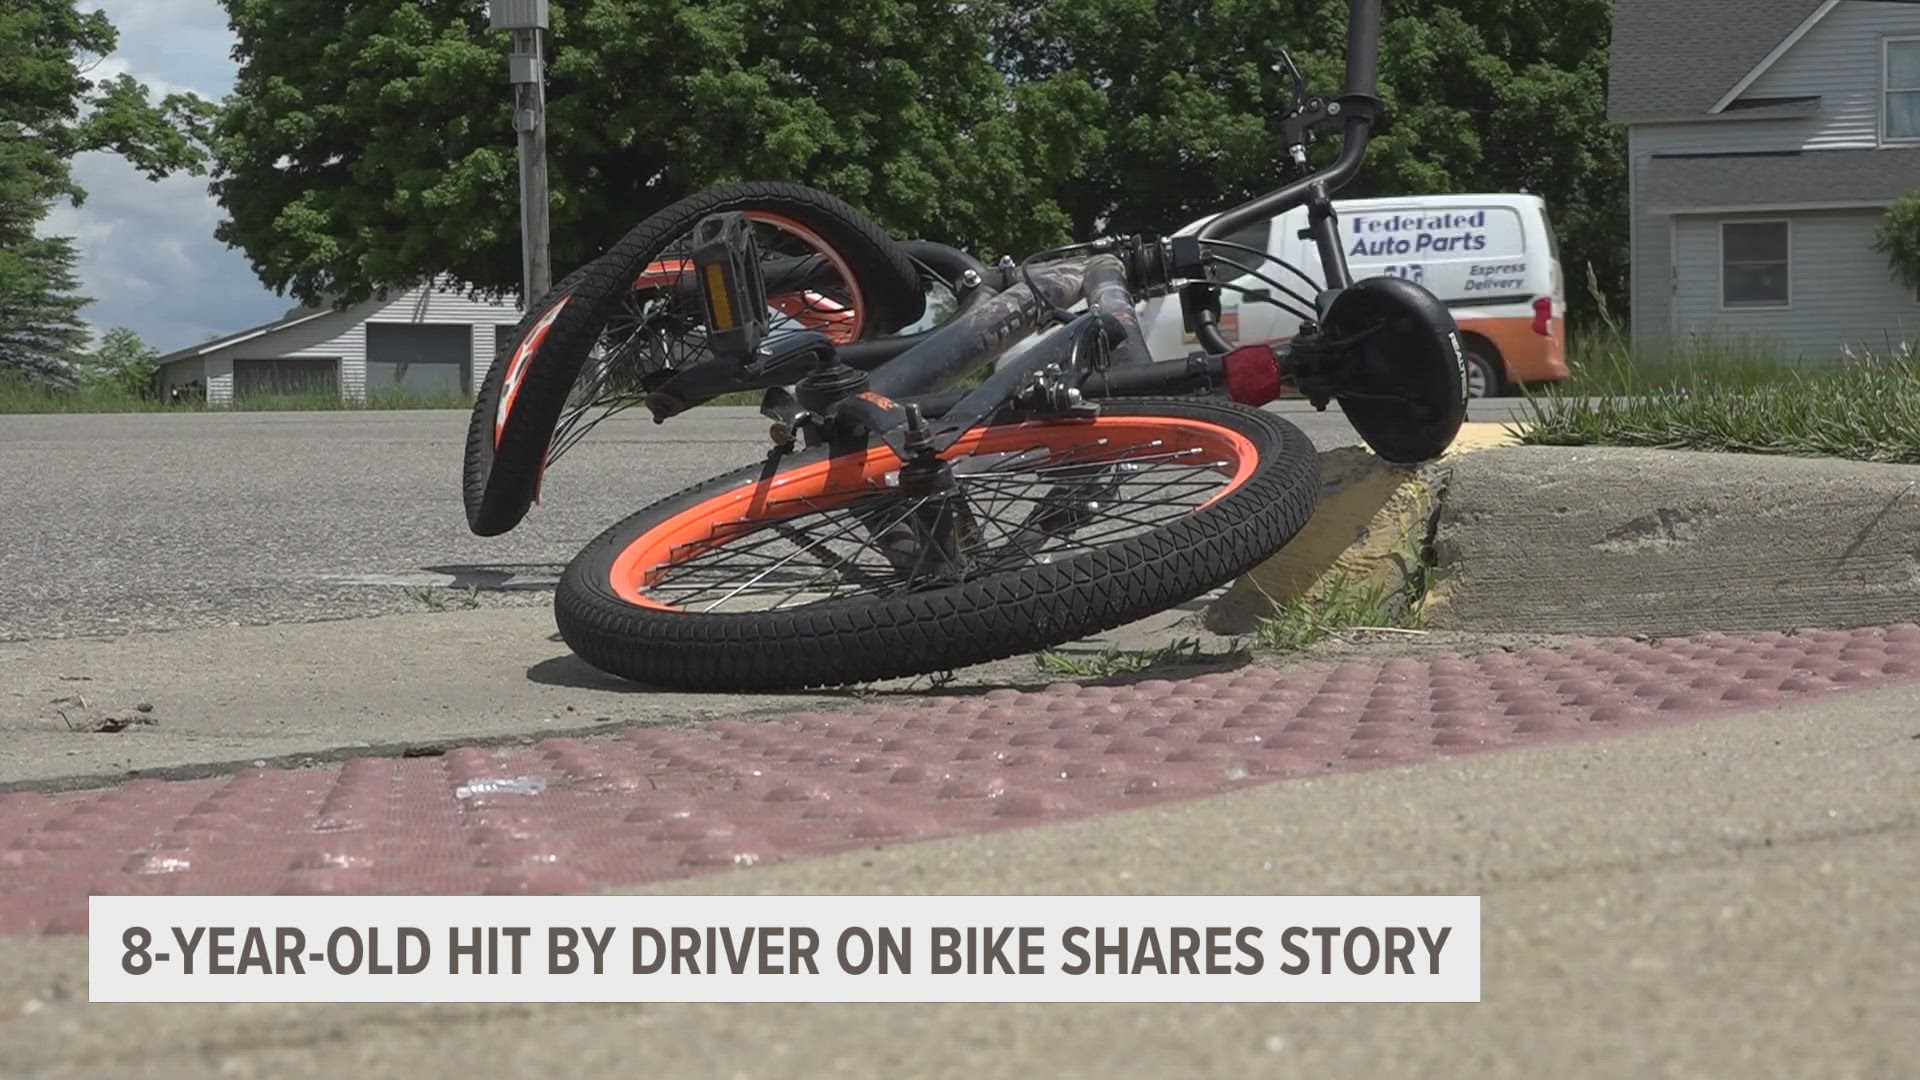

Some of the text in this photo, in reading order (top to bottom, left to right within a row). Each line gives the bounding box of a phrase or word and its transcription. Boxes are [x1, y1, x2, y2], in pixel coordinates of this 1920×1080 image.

[1353, 212, 1485, 234] Federated
[1349, 232, 1486, 256] Auto Parts
[1470, 263, 1526, 276] Express
[1464, 278, 1524, 291] Delivery
